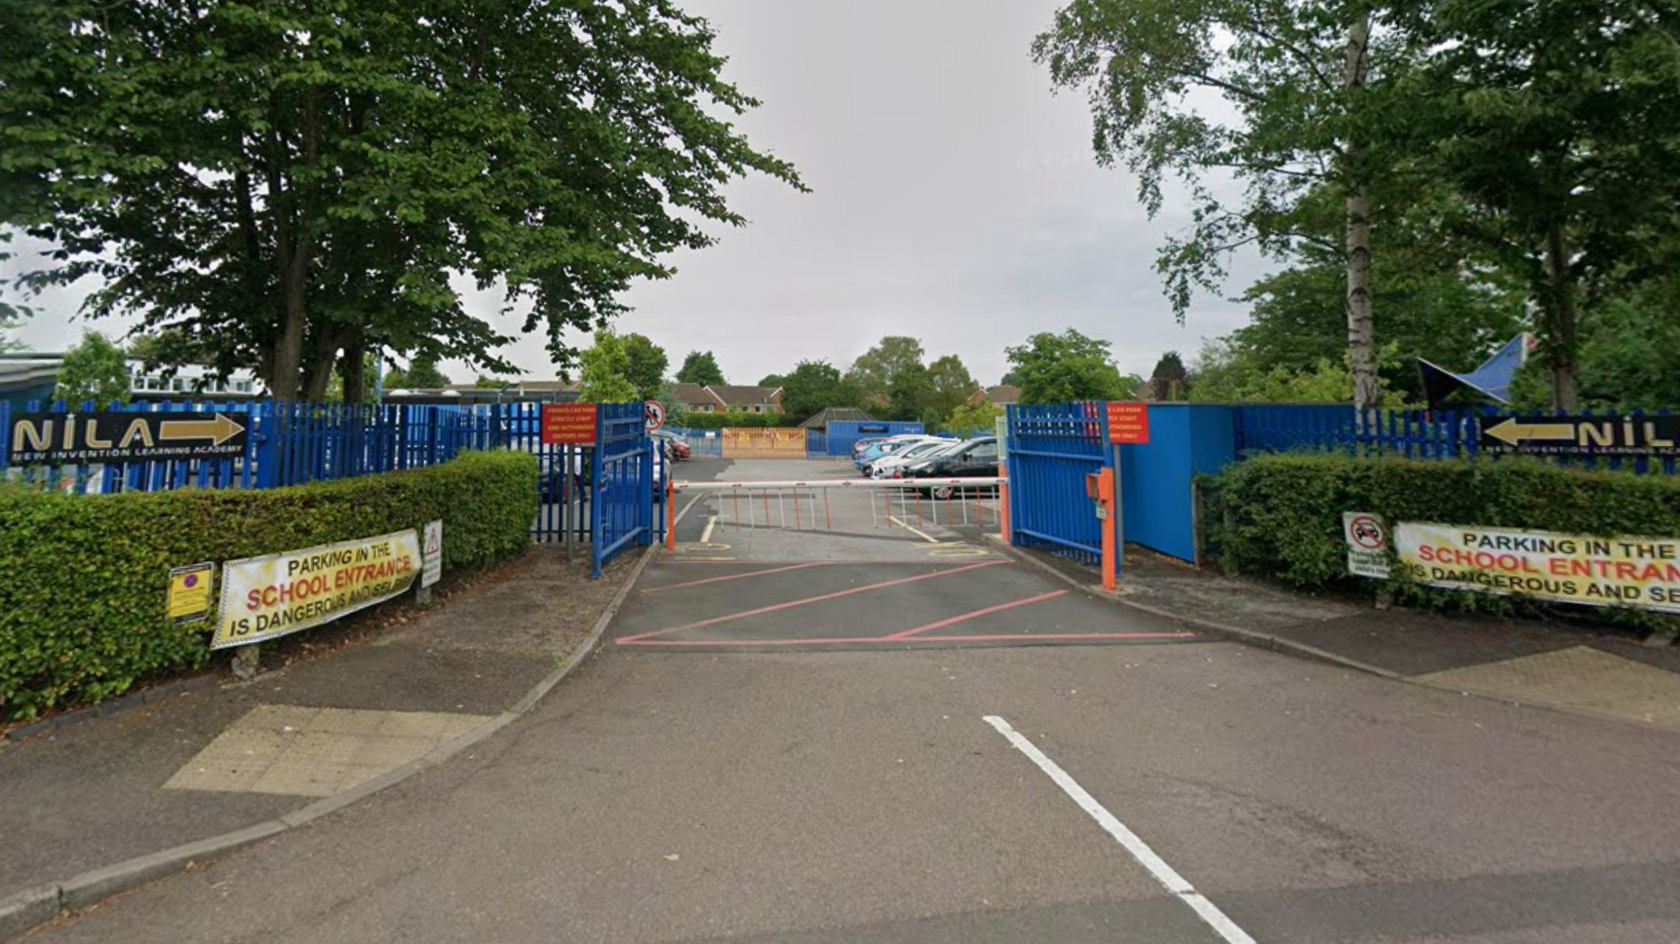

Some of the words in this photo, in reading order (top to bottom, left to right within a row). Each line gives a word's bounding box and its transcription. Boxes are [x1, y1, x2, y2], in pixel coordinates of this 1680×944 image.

[13, 412, 155, 451] NILA
[12, 452, 46, 460] NEW
[51, 448, 130, 459] INVENTION
[134, 445, 191, 456] LEARNING
[193, 440, 242, 453] ACADEMY
[288, 549, 352, 577] PARKING
[356, 546, 369, 562] IN
[371, 542, 391, 559] THE
[1418, 544, 1540, 574] SCHOOL
[1463, 533, 1576, 555] PARKING
[1585, 540, 1610, 556] IN
[1618, 543, 1676, 559] THE
[246, 574, 330, 611] SCHOOL
[335, 555, 411, 587] ENTRANCE
[1410, 563, 1427, 577] IS
[1431, 567, 1577, 595] DANGEROUS
[1586, 583, 1641, 599] AND
[229, 617, 250, 636] IS
[256, 593, 346, 632] DANGEROUS
[348, 585, 370, 605] AND
